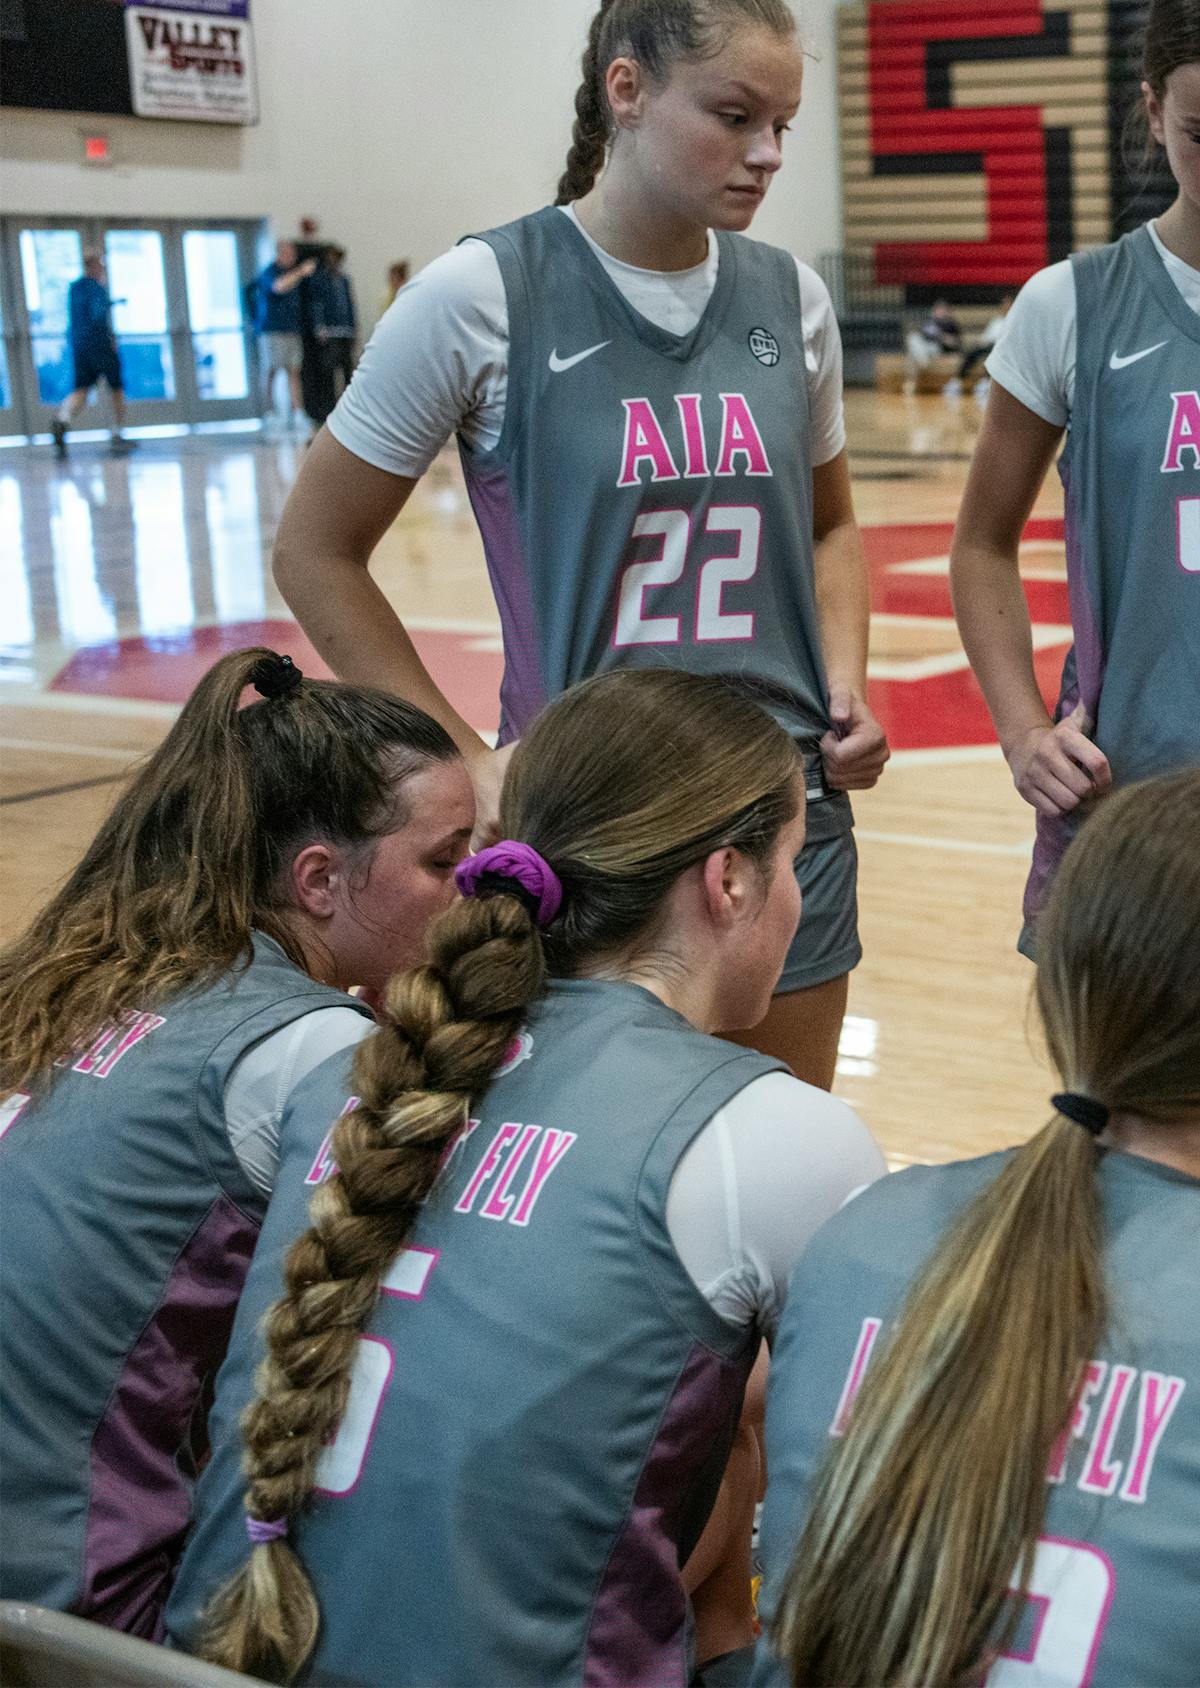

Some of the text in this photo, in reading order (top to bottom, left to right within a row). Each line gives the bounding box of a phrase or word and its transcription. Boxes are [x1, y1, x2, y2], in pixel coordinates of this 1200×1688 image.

[616, 393, 773, 488] AIA
[612, 503, 762, 650] 22
[454, 1122, 578, 1227] FLY
[1046, 1360, 1186, 1504] FLY
